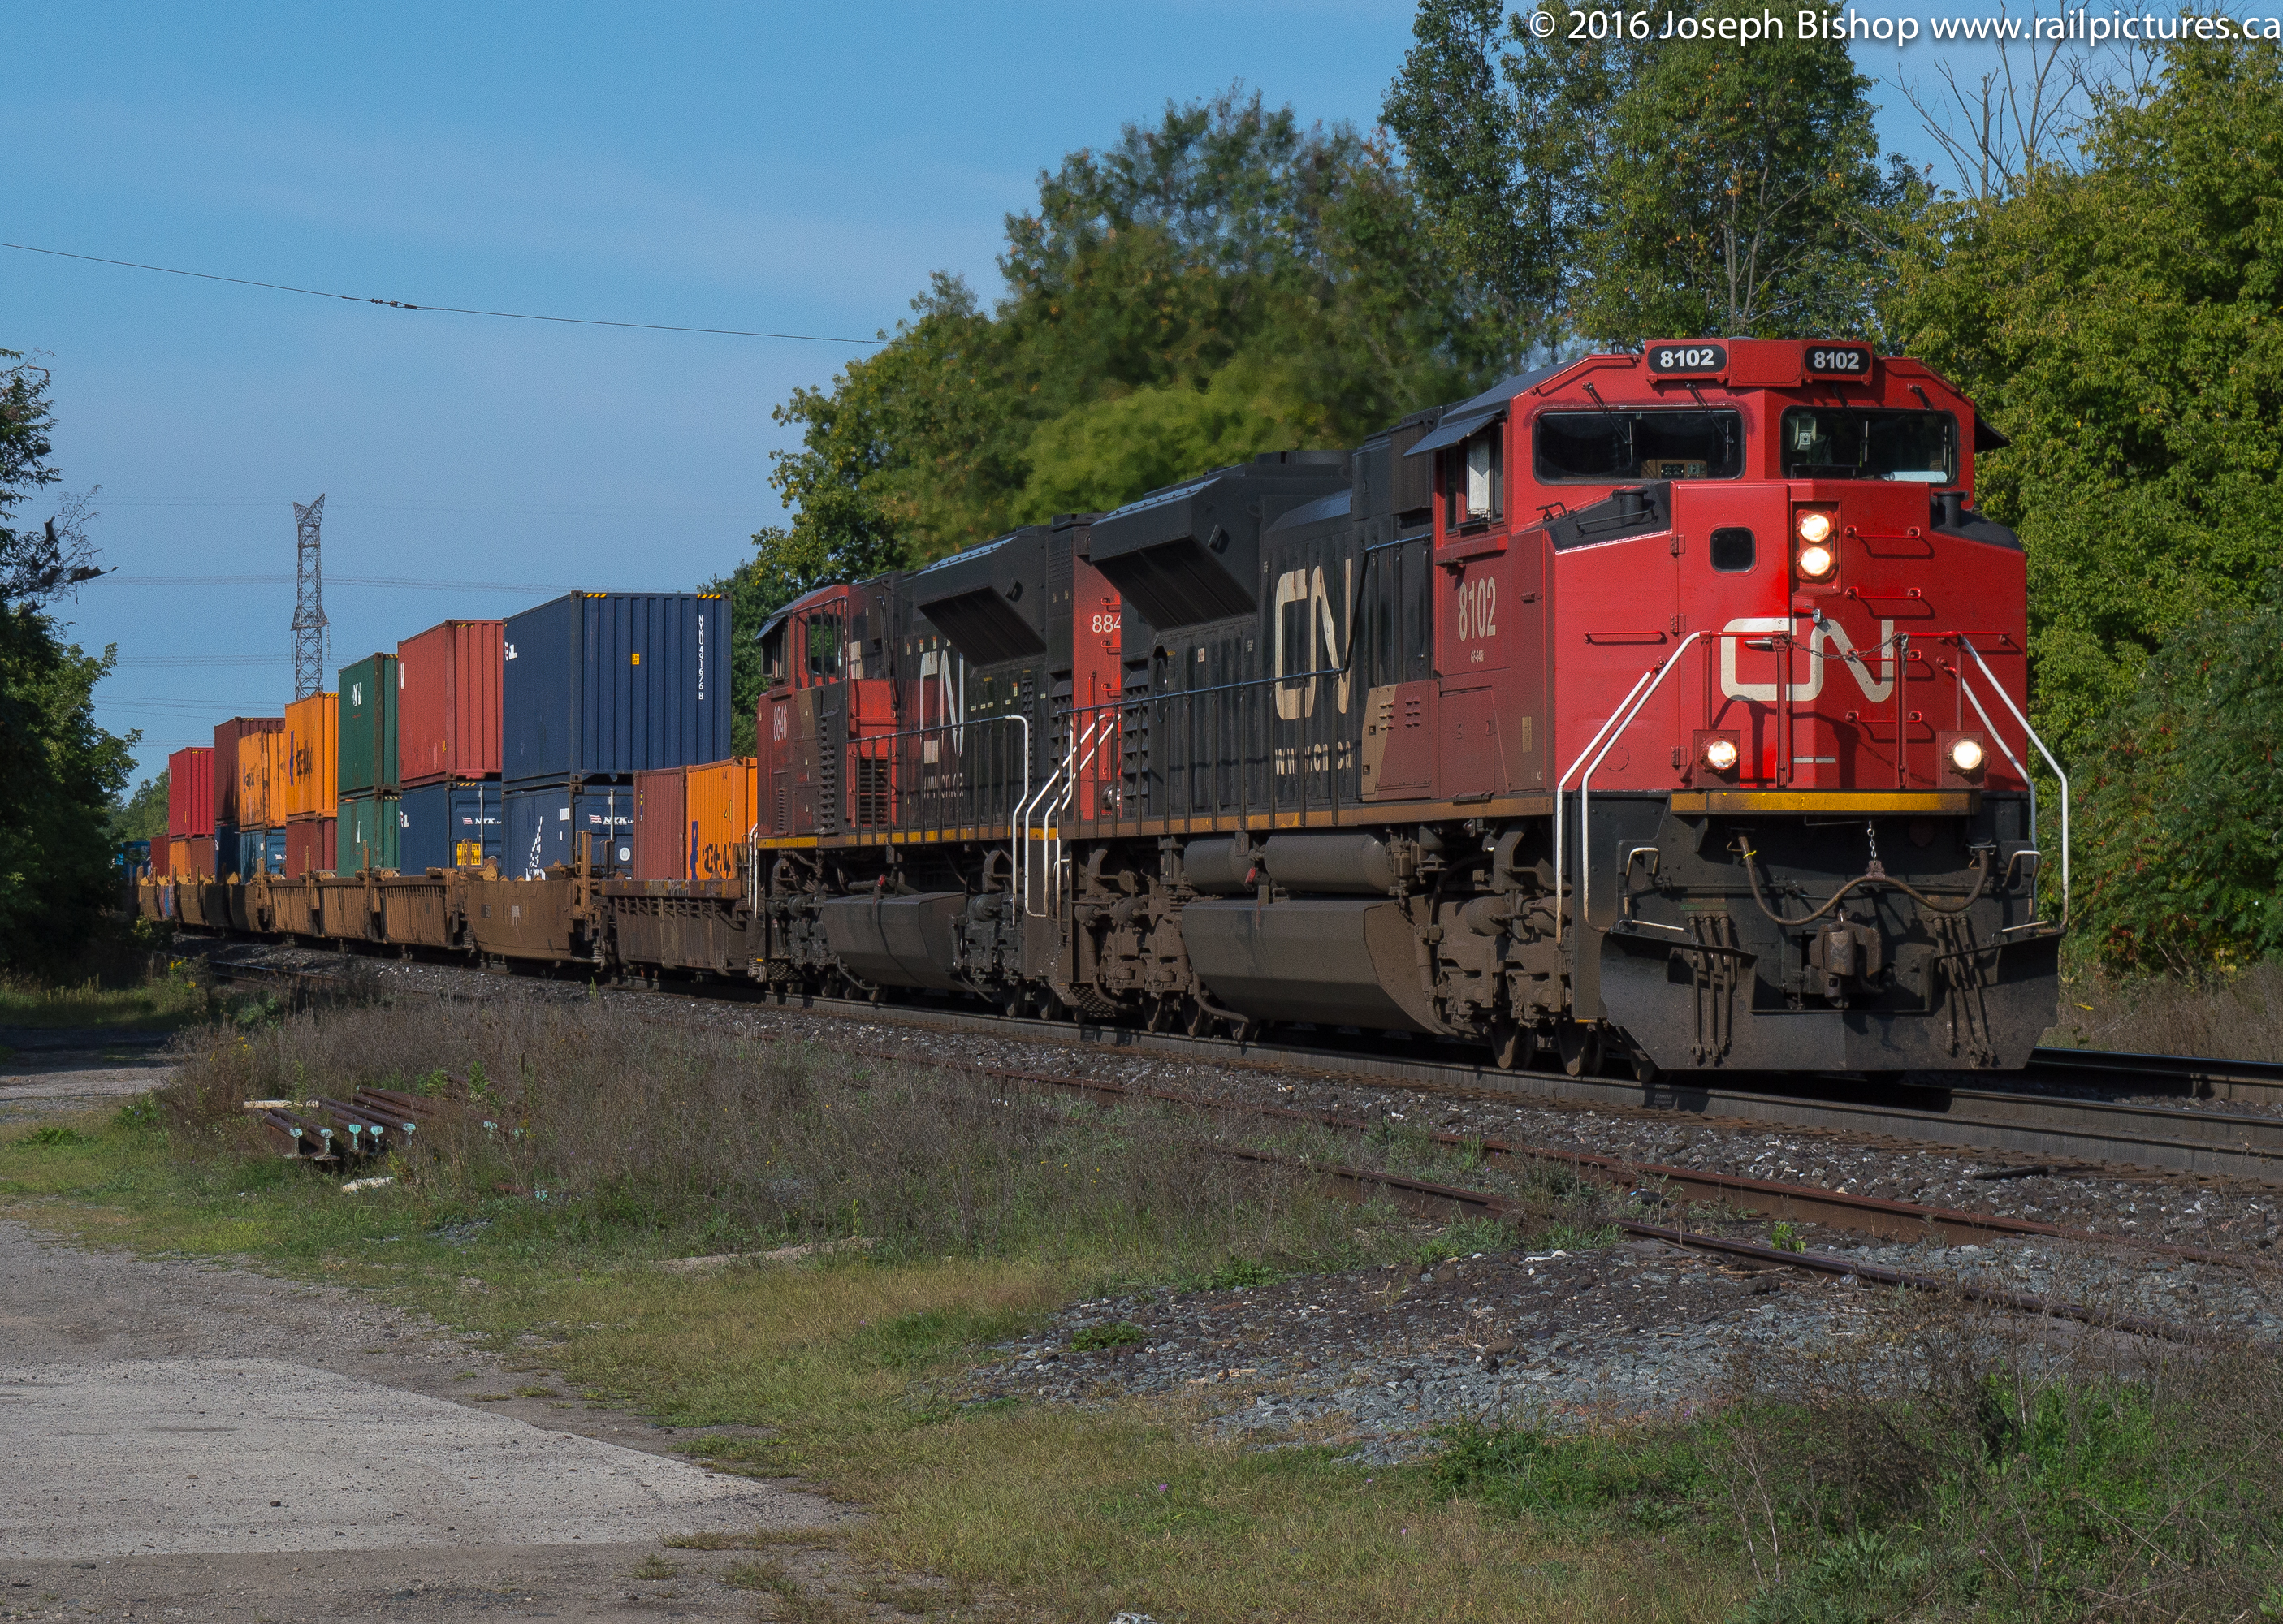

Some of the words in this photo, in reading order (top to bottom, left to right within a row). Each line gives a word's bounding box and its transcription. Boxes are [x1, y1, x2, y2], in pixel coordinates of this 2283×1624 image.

[1660, 349, 1714, 367] 8102
[1814, 352, 1860, 369] 8102
[1092, 614, 1121, 633] 884
[1459, 576, 1496, 641] 8102
[1275, 558, 1351, 720] CN
[1720, 617, 1895, 703] CN
[773, 704, 788, 742] 8846
[919, 649, 964, 764] CN
